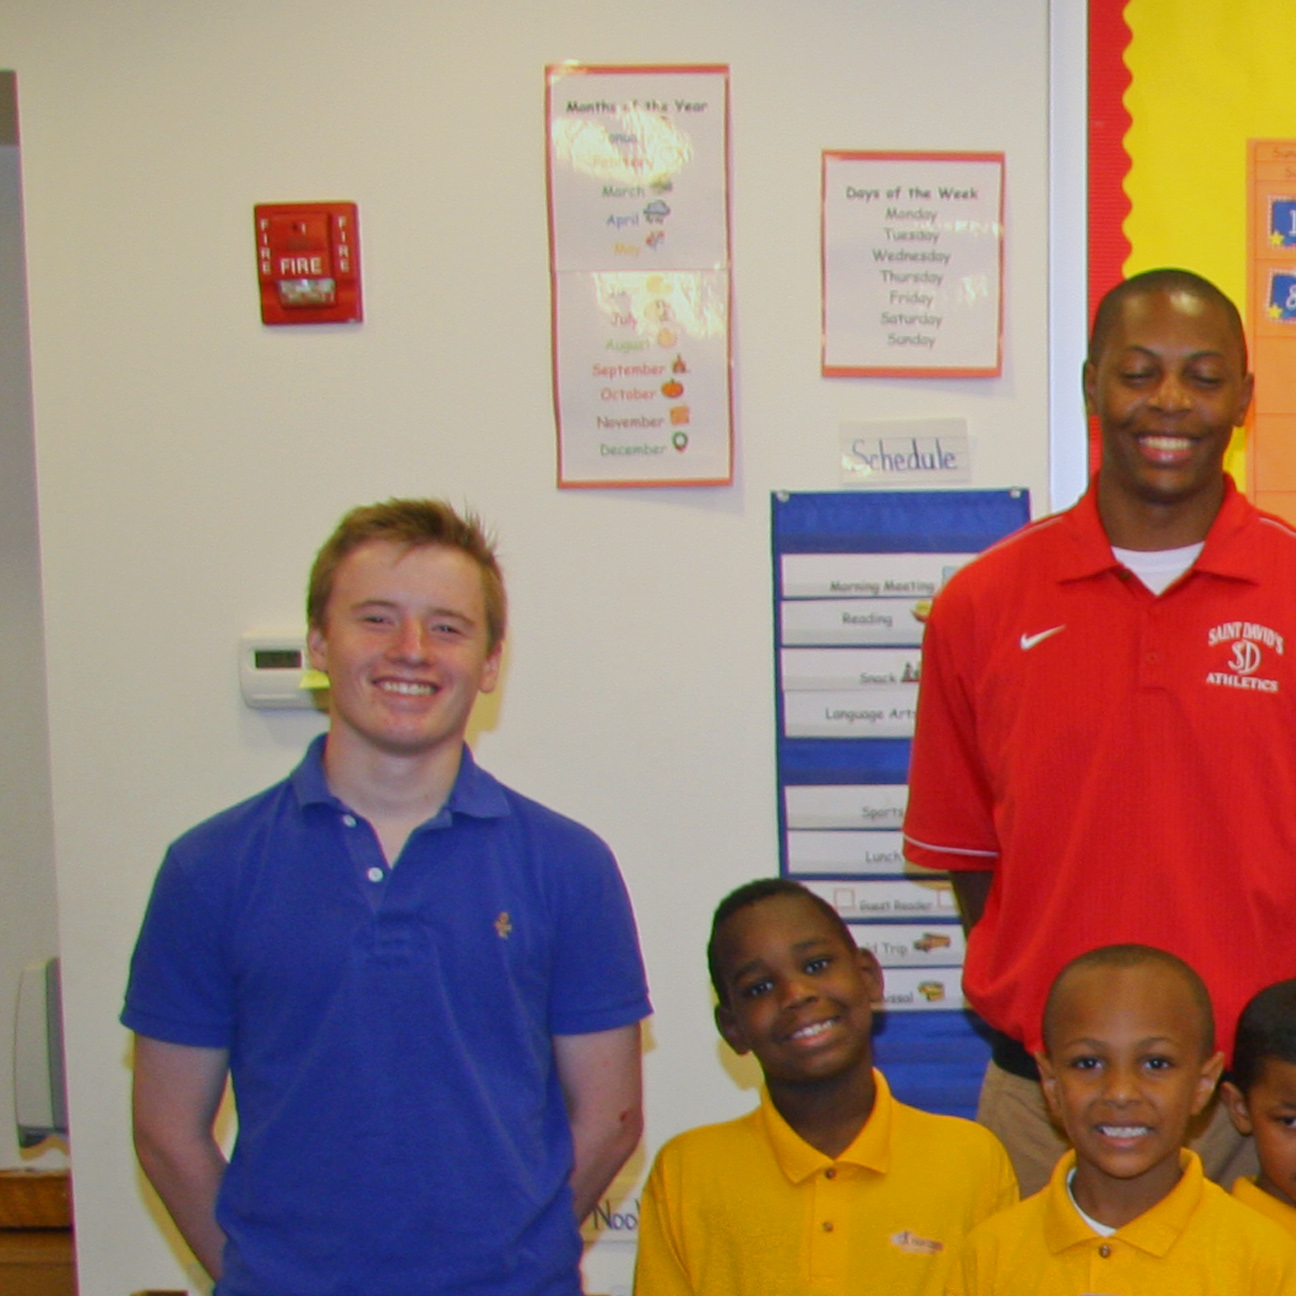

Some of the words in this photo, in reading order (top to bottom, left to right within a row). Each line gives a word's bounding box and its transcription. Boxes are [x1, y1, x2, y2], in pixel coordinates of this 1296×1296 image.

[566, 100, 616, 113] Months
[674, 100, 709, 112] Year
[602, 184, 646, 198] March
[846, 186, 880, 203] Days
[886, 186, 901, 199] of
[908, 187, 931, 199] the
[938, 187, 978, 199] Week
[605, 213, 640, 229] April
[885, 207, 938, 224] Monday
[338, 215, 350, 273] FIRE
[884, 227, 940, 244] Tuesday
[260, 218, 271, 275] FIRE
[871, 249, 951, 265] Wednesday
[280, 257, 323, 275] FIRE
[880, 269, 944, 286] Thursday
[889, 290, 934, 307] Friday
[880, 311, 943, 329] Saturday
[887, 333, 936, 350] Sunday
[592, 363, 667, 380] September
[600, 386, 658, 401] October
[596, 415, 665, 430] November
[599, 442, 667, 457] December
[852, 438, 957, 472] Schedule
[830, 581, 881, 595] Morning
[883, 581, 935, 594] Meeting
[842, 612, 893, 627] Reading
[1207, 621, 1243, 647] SAINT
[859, 672, 896, 684] Snack
[1205, 672, 1279, 693] ATHLETICS
[825, 707, 884, 722] Language
[865, 851, 902, 863] Lunch
[894, 900, 933, 912] Reader
[882, 942, 908, 958] Trip
[594, 1200, 640, 1231] Noo
